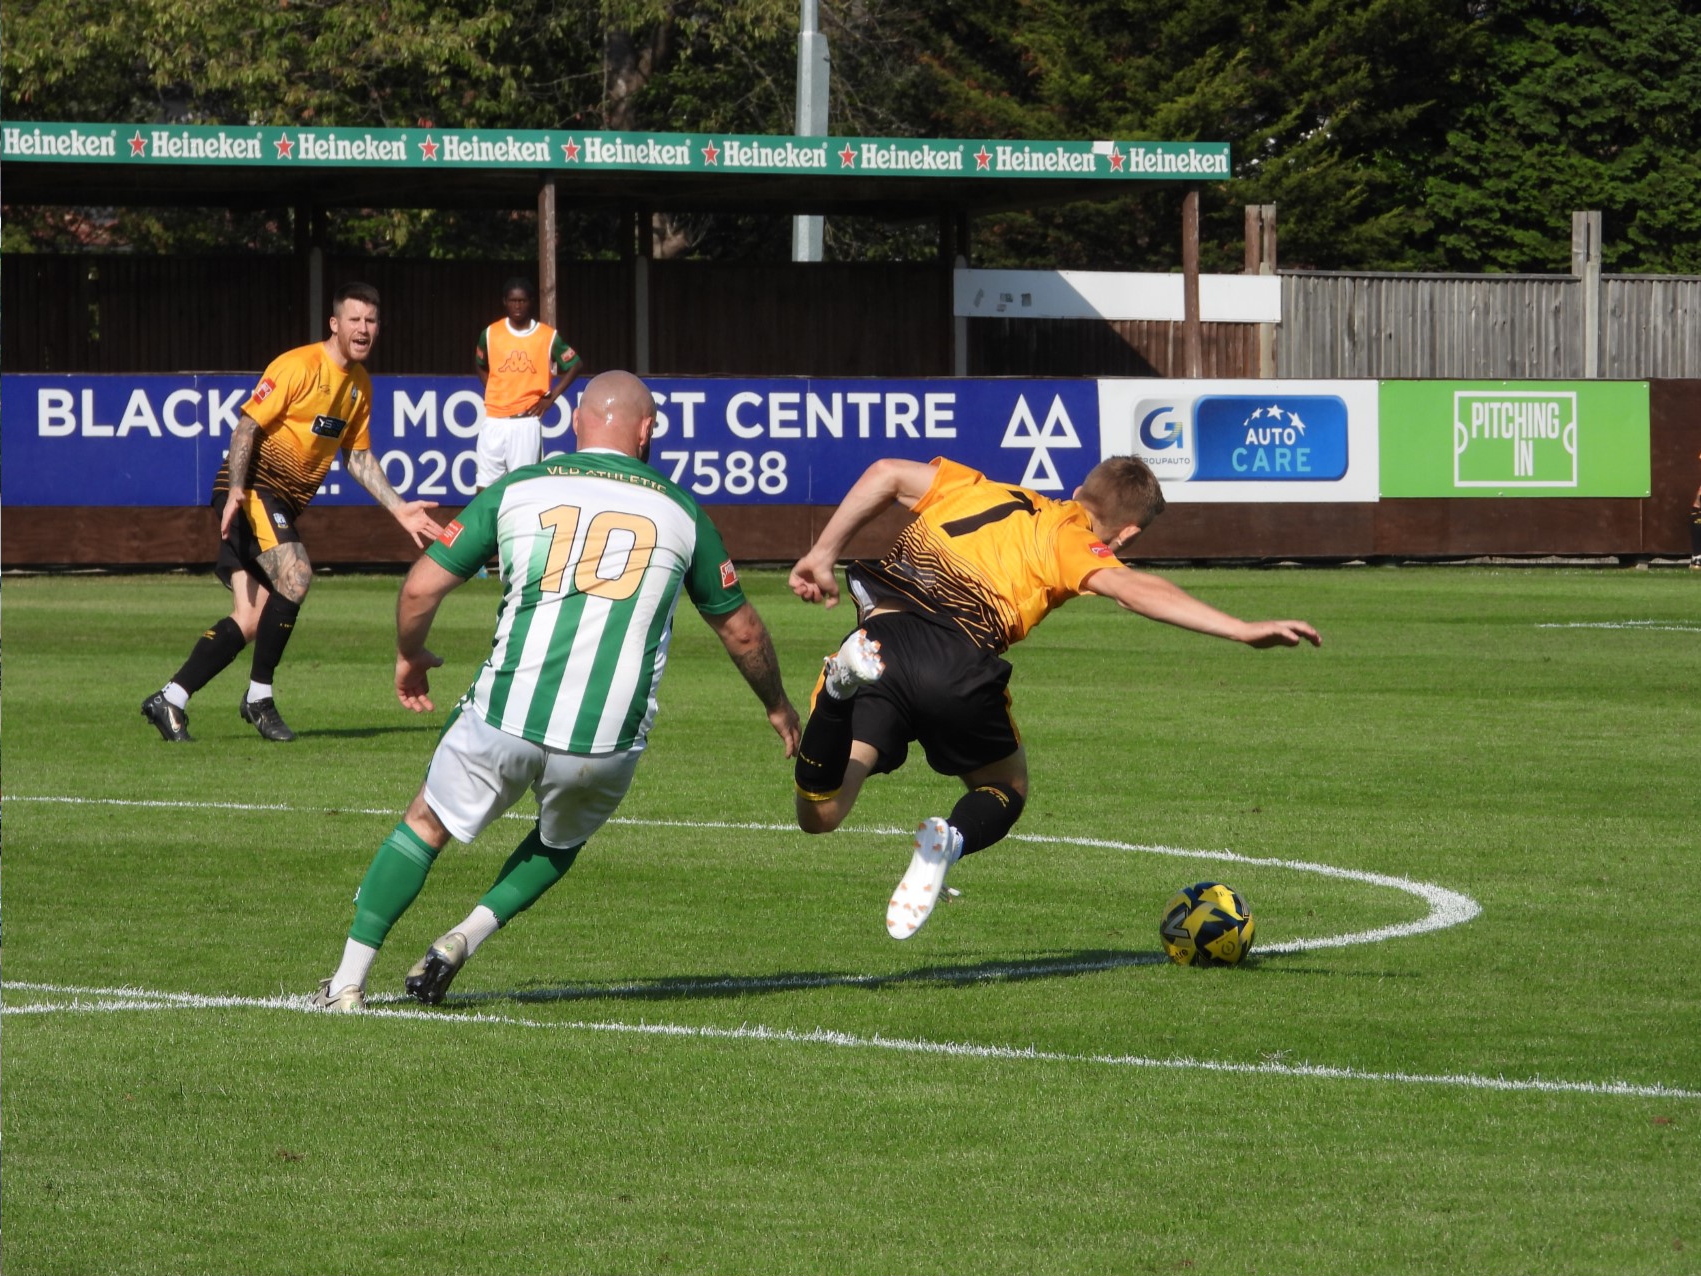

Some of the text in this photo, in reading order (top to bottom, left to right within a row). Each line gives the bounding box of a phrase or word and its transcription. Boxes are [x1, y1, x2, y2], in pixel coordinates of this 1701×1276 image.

[2, 129, 1228, 174] Heineken Heineken Heineken Heineken Heineken Heineken Heineken Heineken Heineken
[37, 388, 253, 438] BLACK
[725, 390, 957, 439] CENTRE
[1471, 402, 1560, 441] PITCHING
[1245, 428, 1296, 446] AUTO
[1514, 437, 1534, 476] IN
[381, 450, 788, 496] 020 7588
[1231, 447, 1312, 473] CARE
[538, 504, 658, 600] 10
